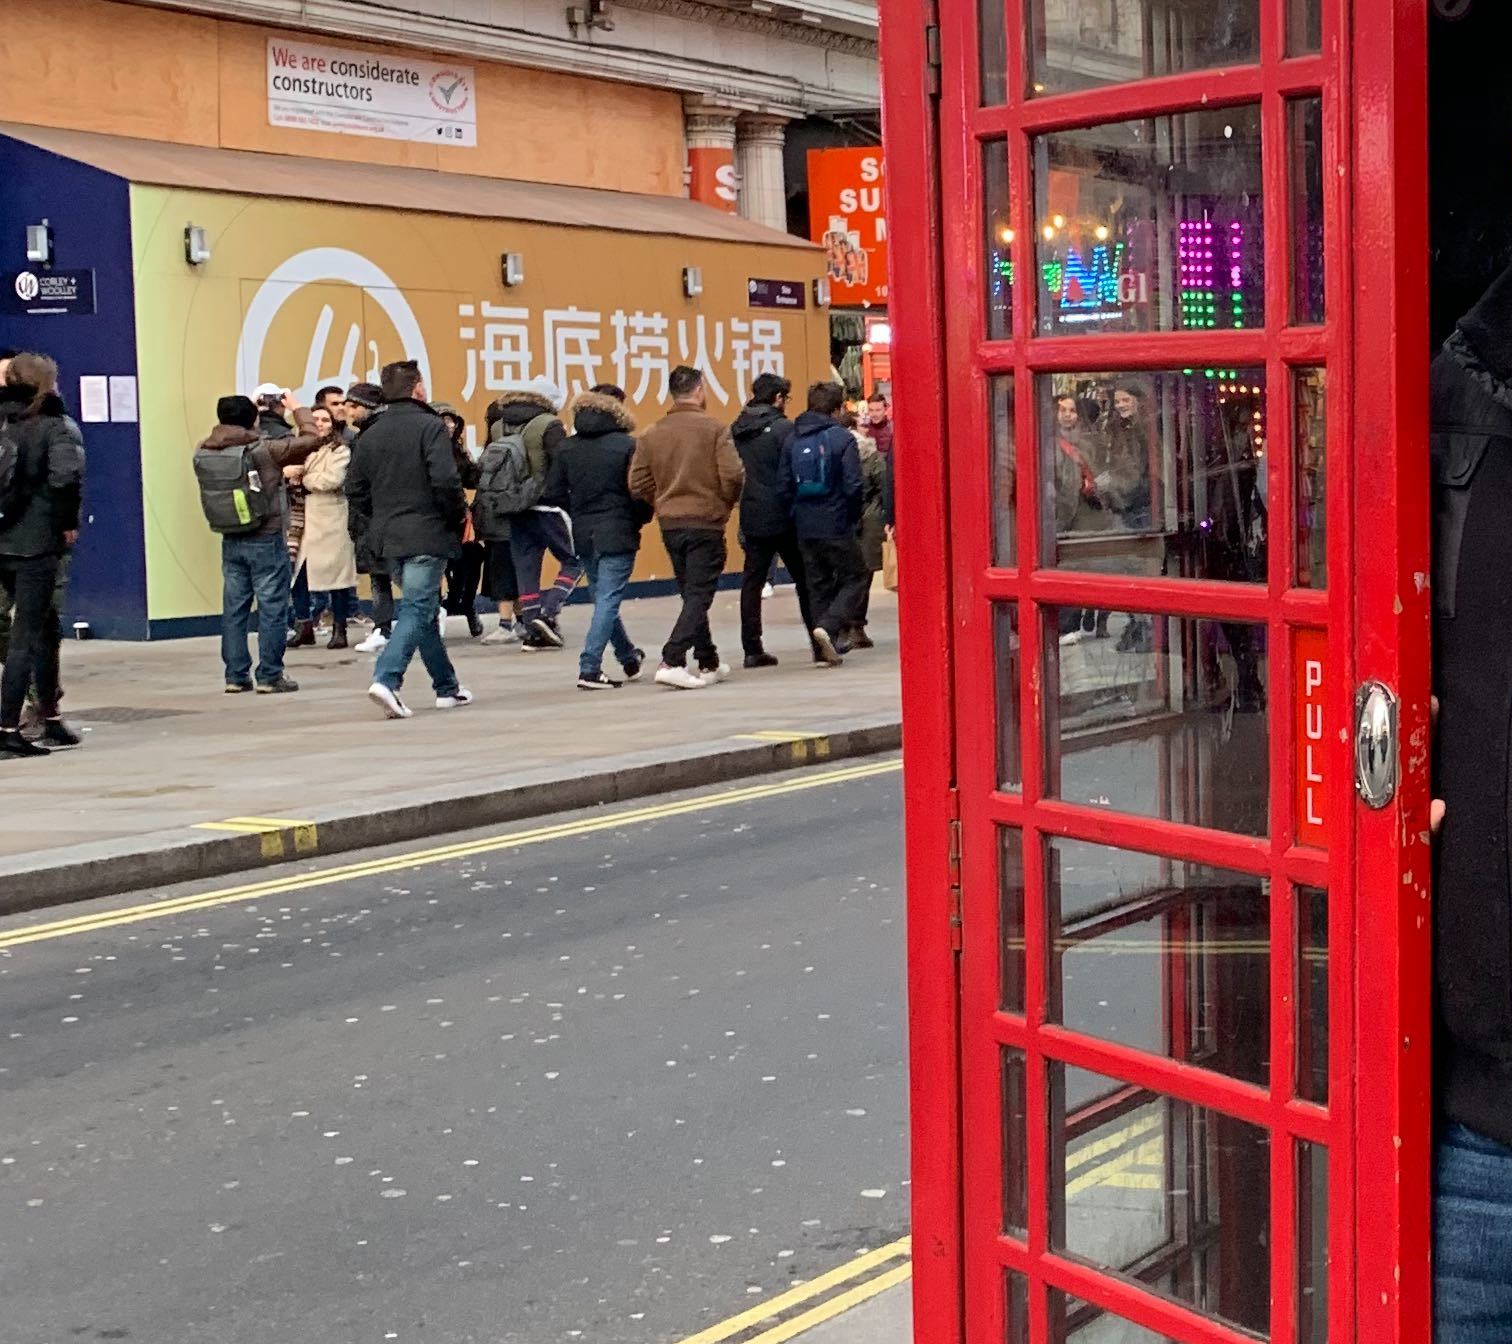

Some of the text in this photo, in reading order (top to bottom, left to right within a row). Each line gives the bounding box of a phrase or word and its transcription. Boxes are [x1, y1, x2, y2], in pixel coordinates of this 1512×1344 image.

[272, 46, 420, 86] We are considerate
[273, 74, 373, 102] constructors
[459, 301, 785, 406] 海底捞火锅
[1306, 660, 1323, 825] PULL
